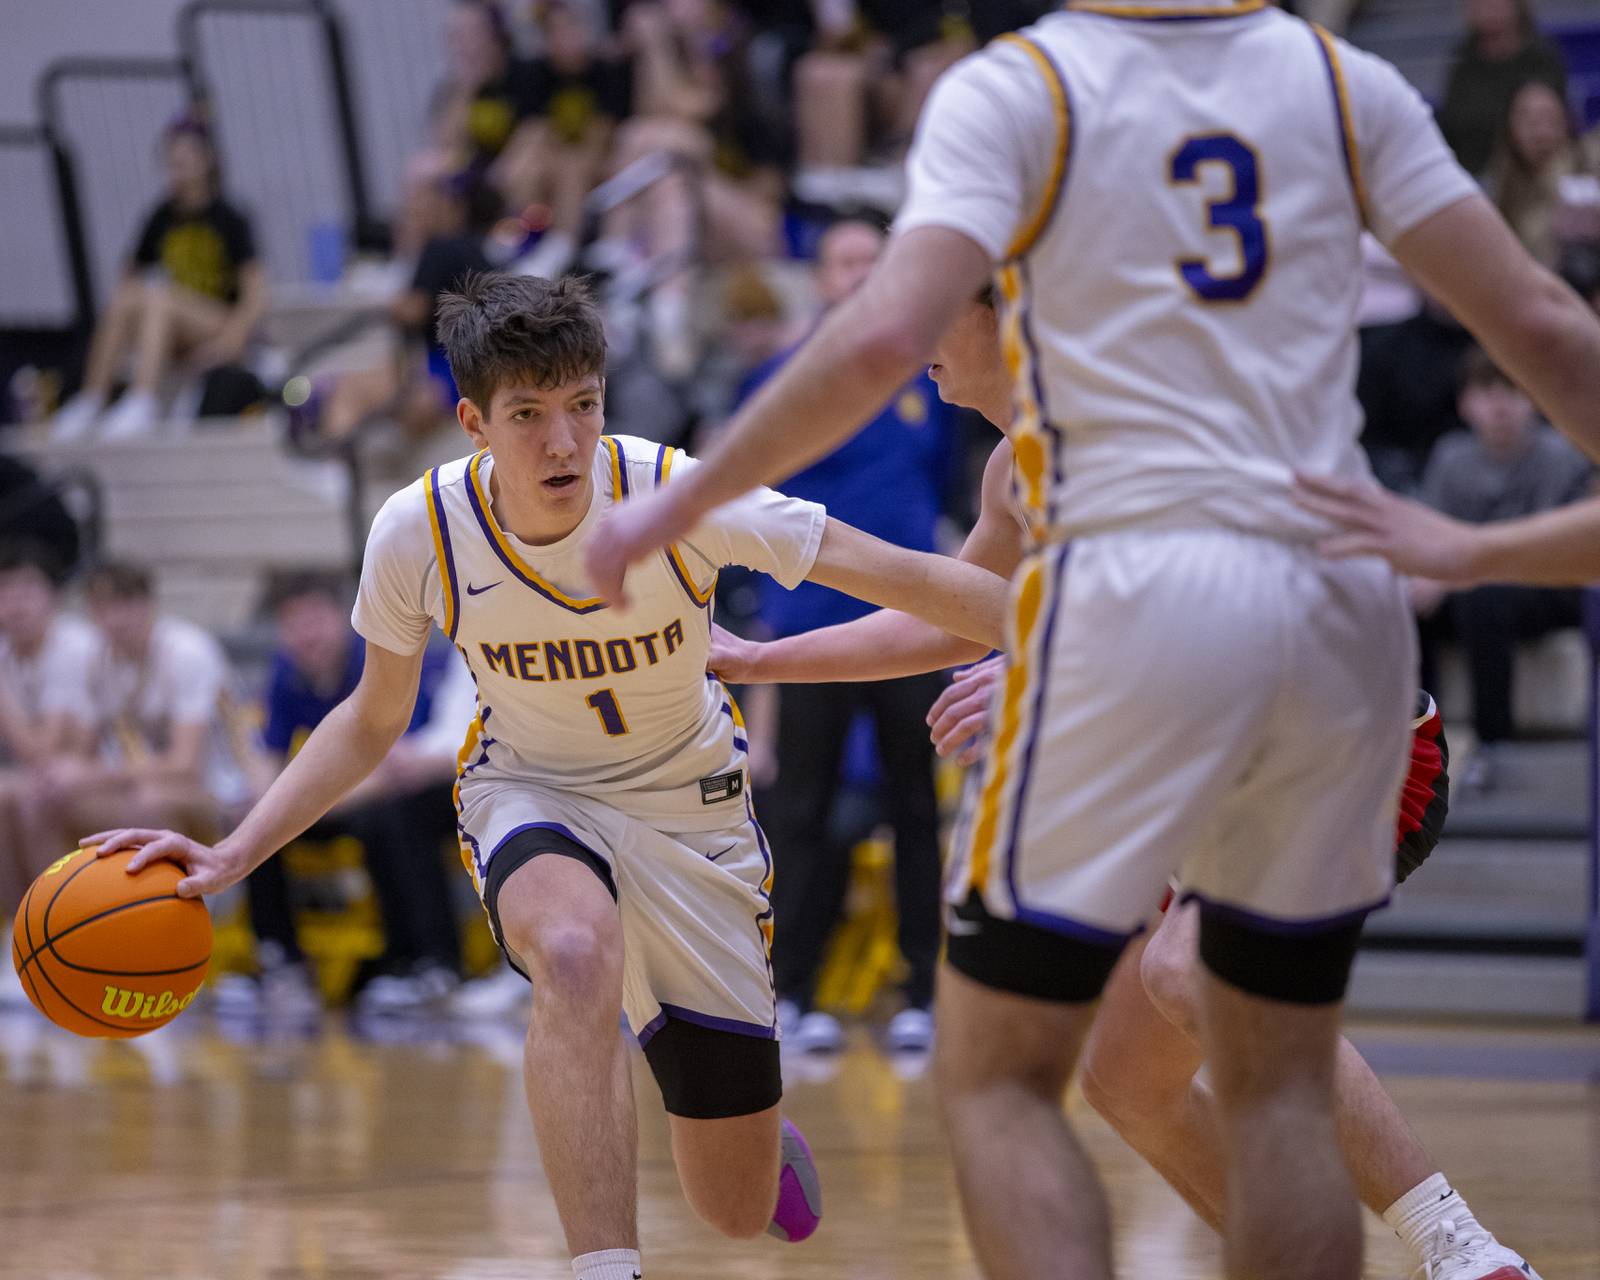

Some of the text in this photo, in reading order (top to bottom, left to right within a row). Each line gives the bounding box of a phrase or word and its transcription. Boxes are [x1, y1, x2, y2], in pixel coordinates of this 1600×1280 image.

[1166, 131, 1272, 304] 3
[480, 618, 684, 682] MENDOTA
[585, 687, 631, 737] 1
[101, 985, 202, 1019] Wilso
